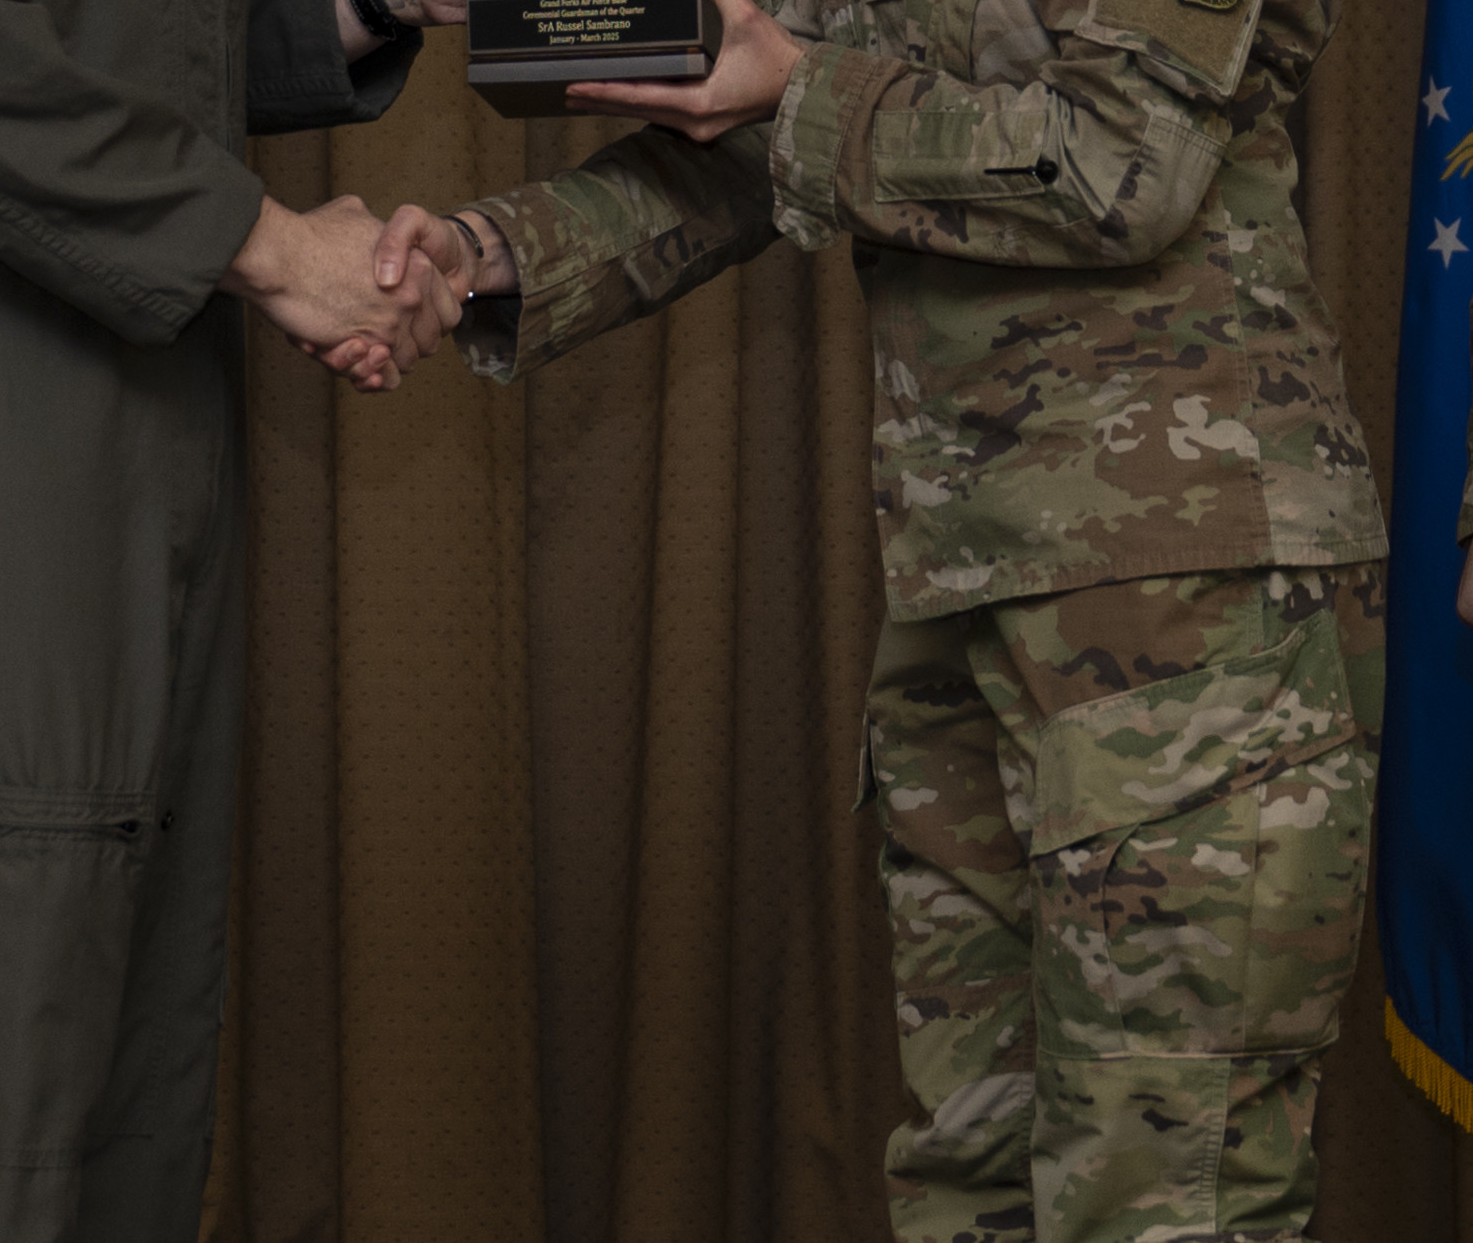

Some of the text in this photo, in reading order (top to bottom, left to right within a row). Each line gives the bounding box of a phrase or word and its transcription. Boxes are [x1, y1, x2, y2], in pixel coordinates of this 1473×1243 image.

[599, 7, 607, 16] of
[607, 7, 618, 16] the
[619, 6, 646, 17] Quarter
[537, 18, 631, 33] SrA Russel Sambrano
[549, 34, 576, 46] January
[580, 33, 602, 43] March
[602, 31, 620, 42] 2025
